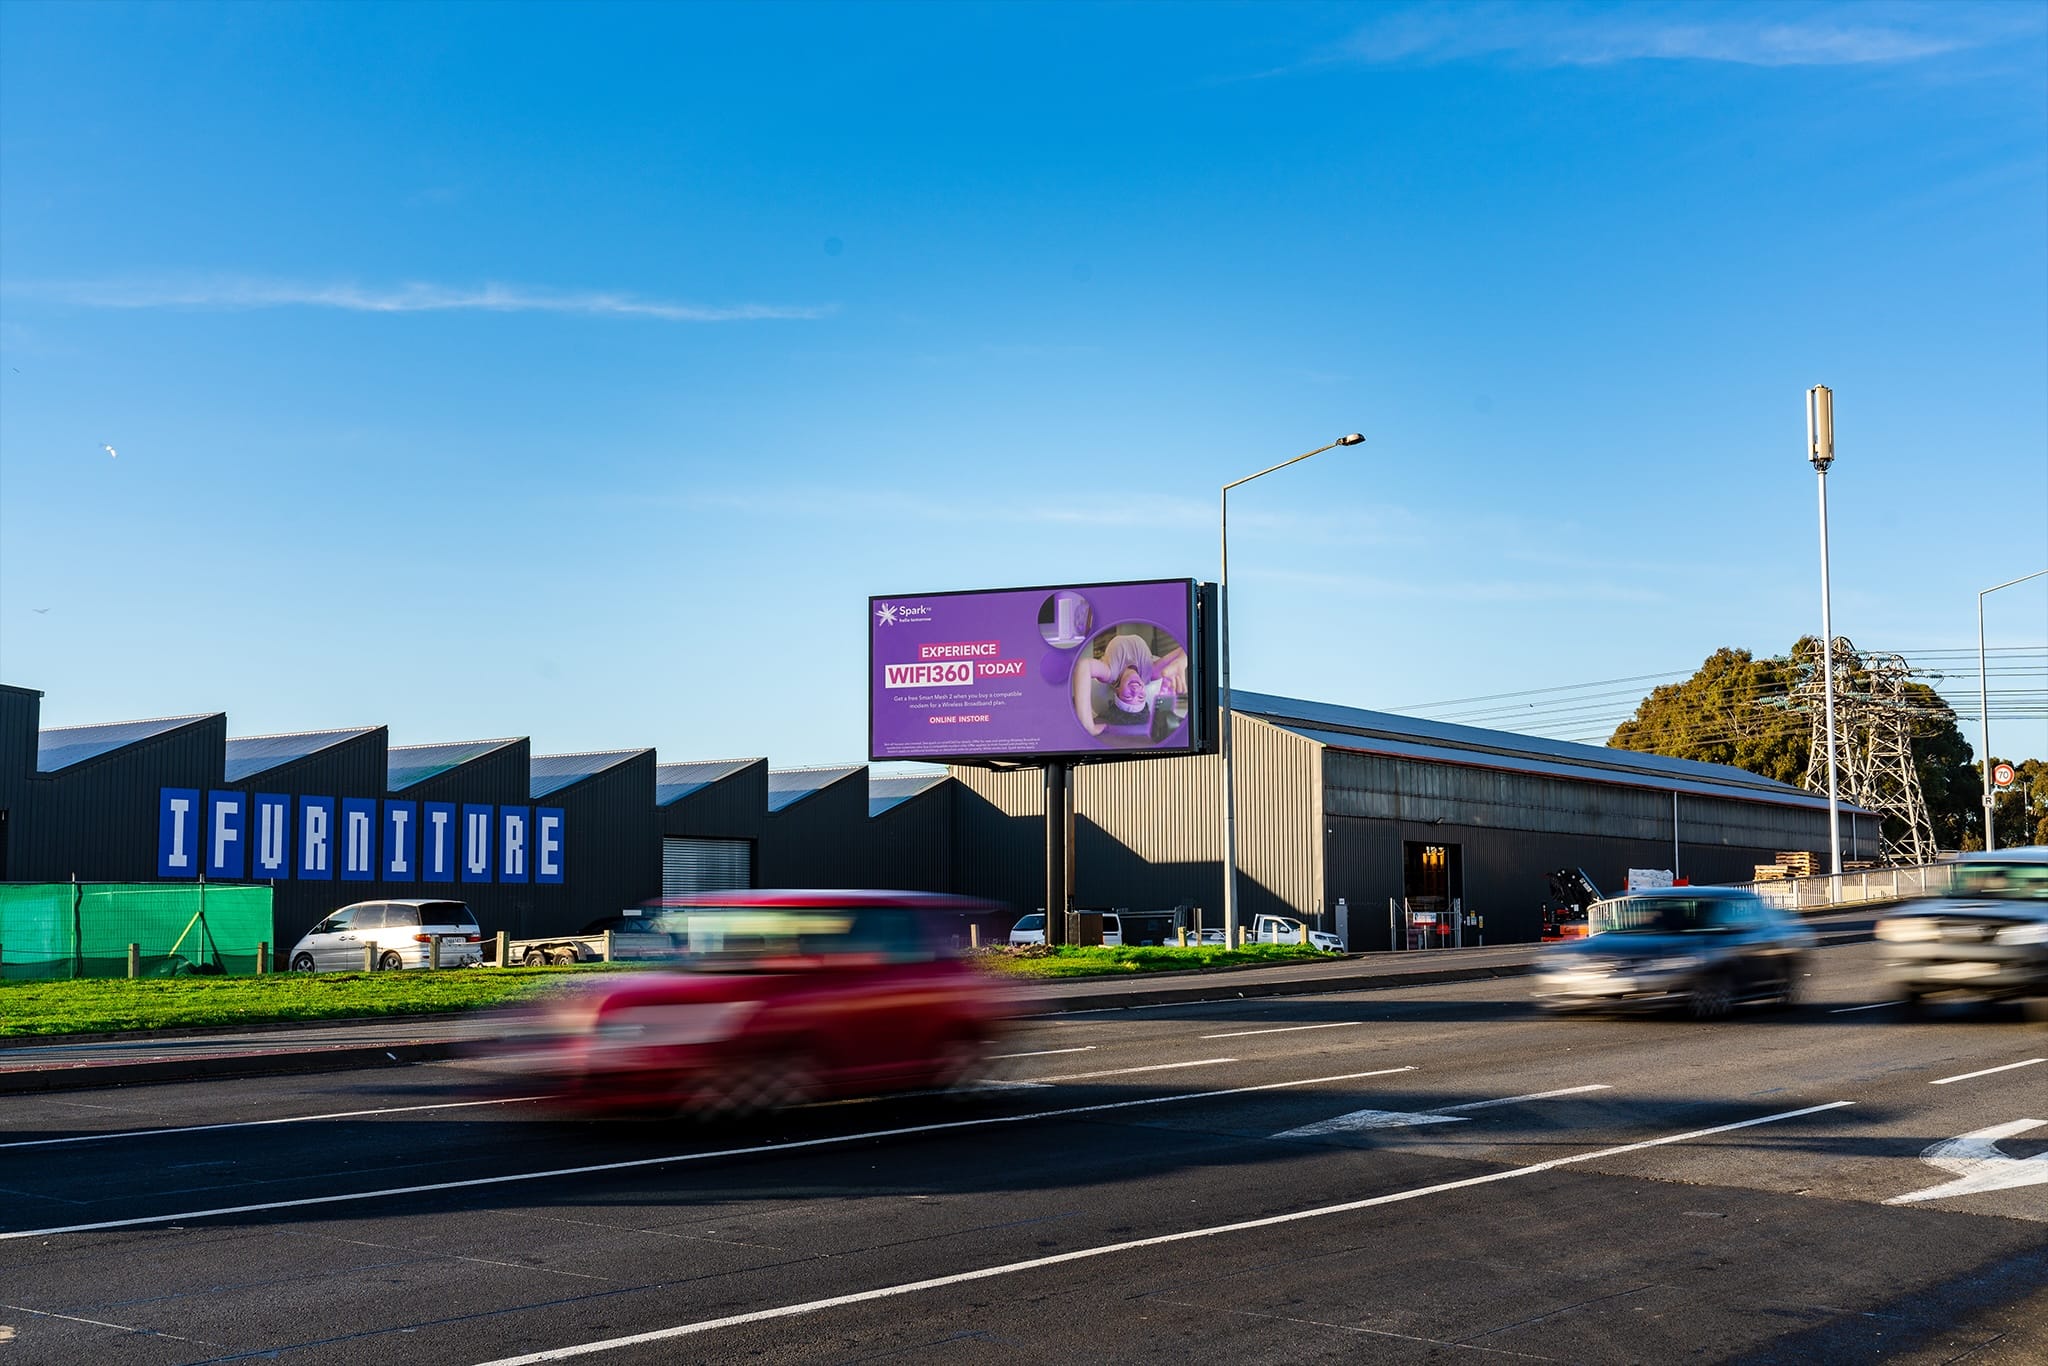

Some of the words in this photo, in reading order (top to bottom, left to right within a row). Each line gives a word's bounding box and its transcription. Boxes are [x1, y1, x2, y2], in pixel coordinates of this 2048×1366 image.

[921, 644, 997, 658] EXPERIENCE
[888, 664, 971, 685] WIFI360
[978, 662, 1023, 675] TODAY
[929, 715, 957, 724] ONLINE
[958, 714, 990, 723] INSTORE
[1998, 771, 2009, 779] 70
[1985, 797, 1992, 805] R
